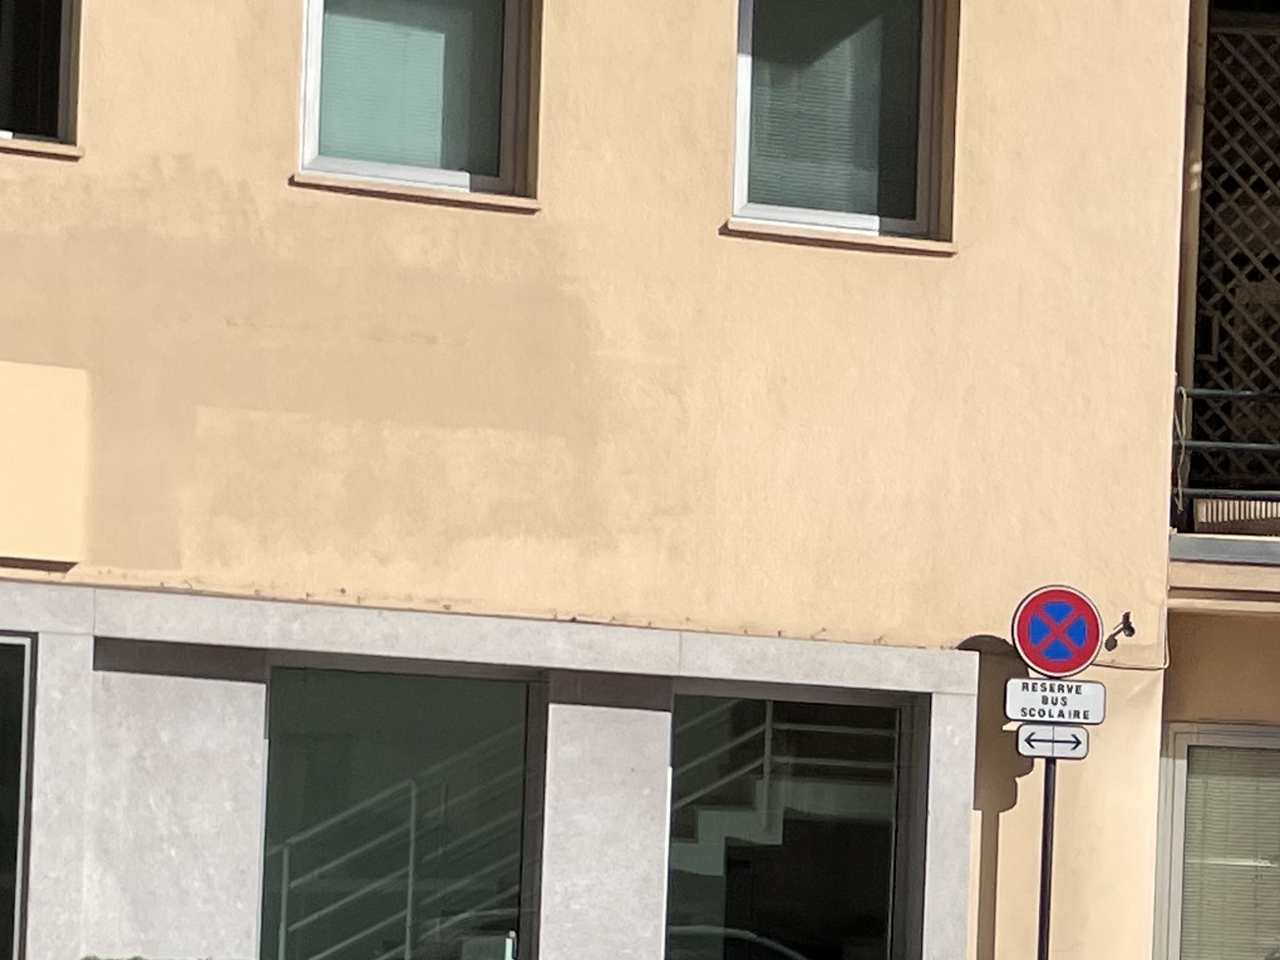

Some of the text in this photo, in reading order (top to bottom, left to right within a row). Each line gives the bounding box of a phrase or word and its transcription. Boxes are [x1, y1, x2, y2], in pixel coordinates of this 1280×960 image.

[1021, 682, 1083, 695] RESERVE
[1041, 695, 1068, 706] BUS
[1021, 707, 1090, 720] SCOLAIRE
